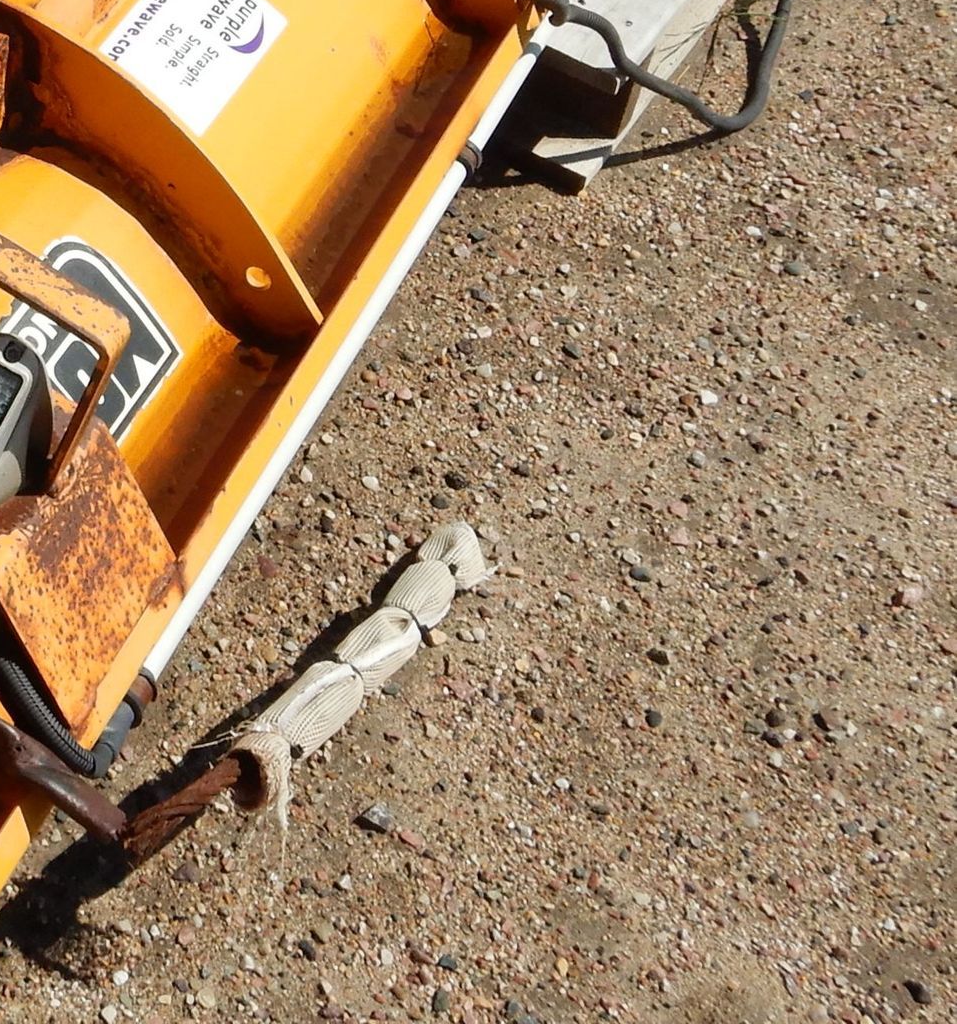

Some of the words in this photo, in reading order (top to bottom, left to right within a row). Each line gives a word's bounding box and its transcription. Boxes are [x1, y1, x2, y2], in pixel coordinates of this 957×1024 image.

[155, 23, 182, 48] Sold.
[165, 36, 201, 69] Simple.
[179, 47, 219, 87] Straight.
